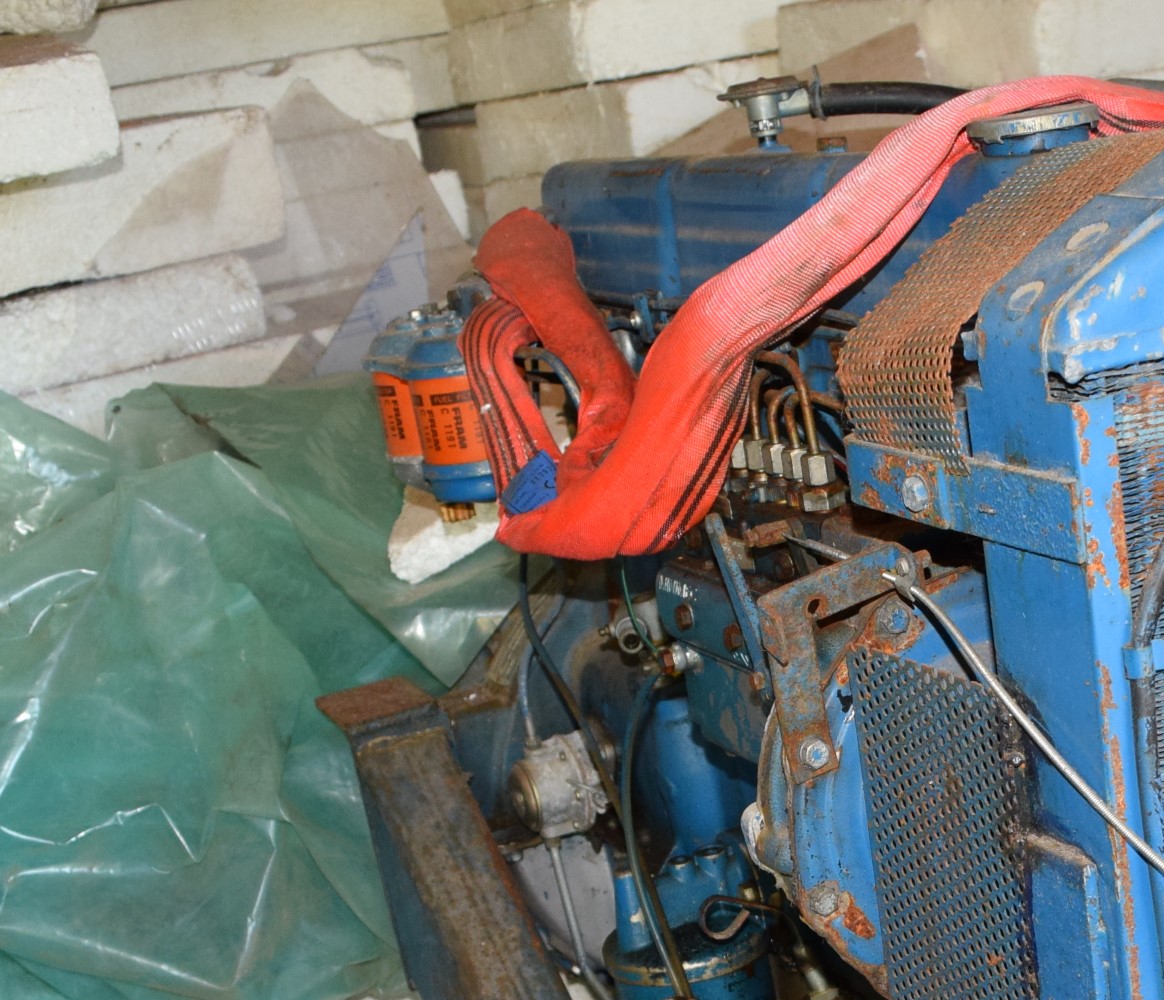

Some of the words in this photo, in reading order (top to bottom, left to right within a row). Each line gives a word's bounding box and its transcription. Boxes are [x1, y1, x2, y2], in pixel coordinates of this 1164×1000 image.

[392, 399, 406, 440] FRAM
[427, 409, 442, 451] FRAM
[451, 406, 467, 449] FRAM
